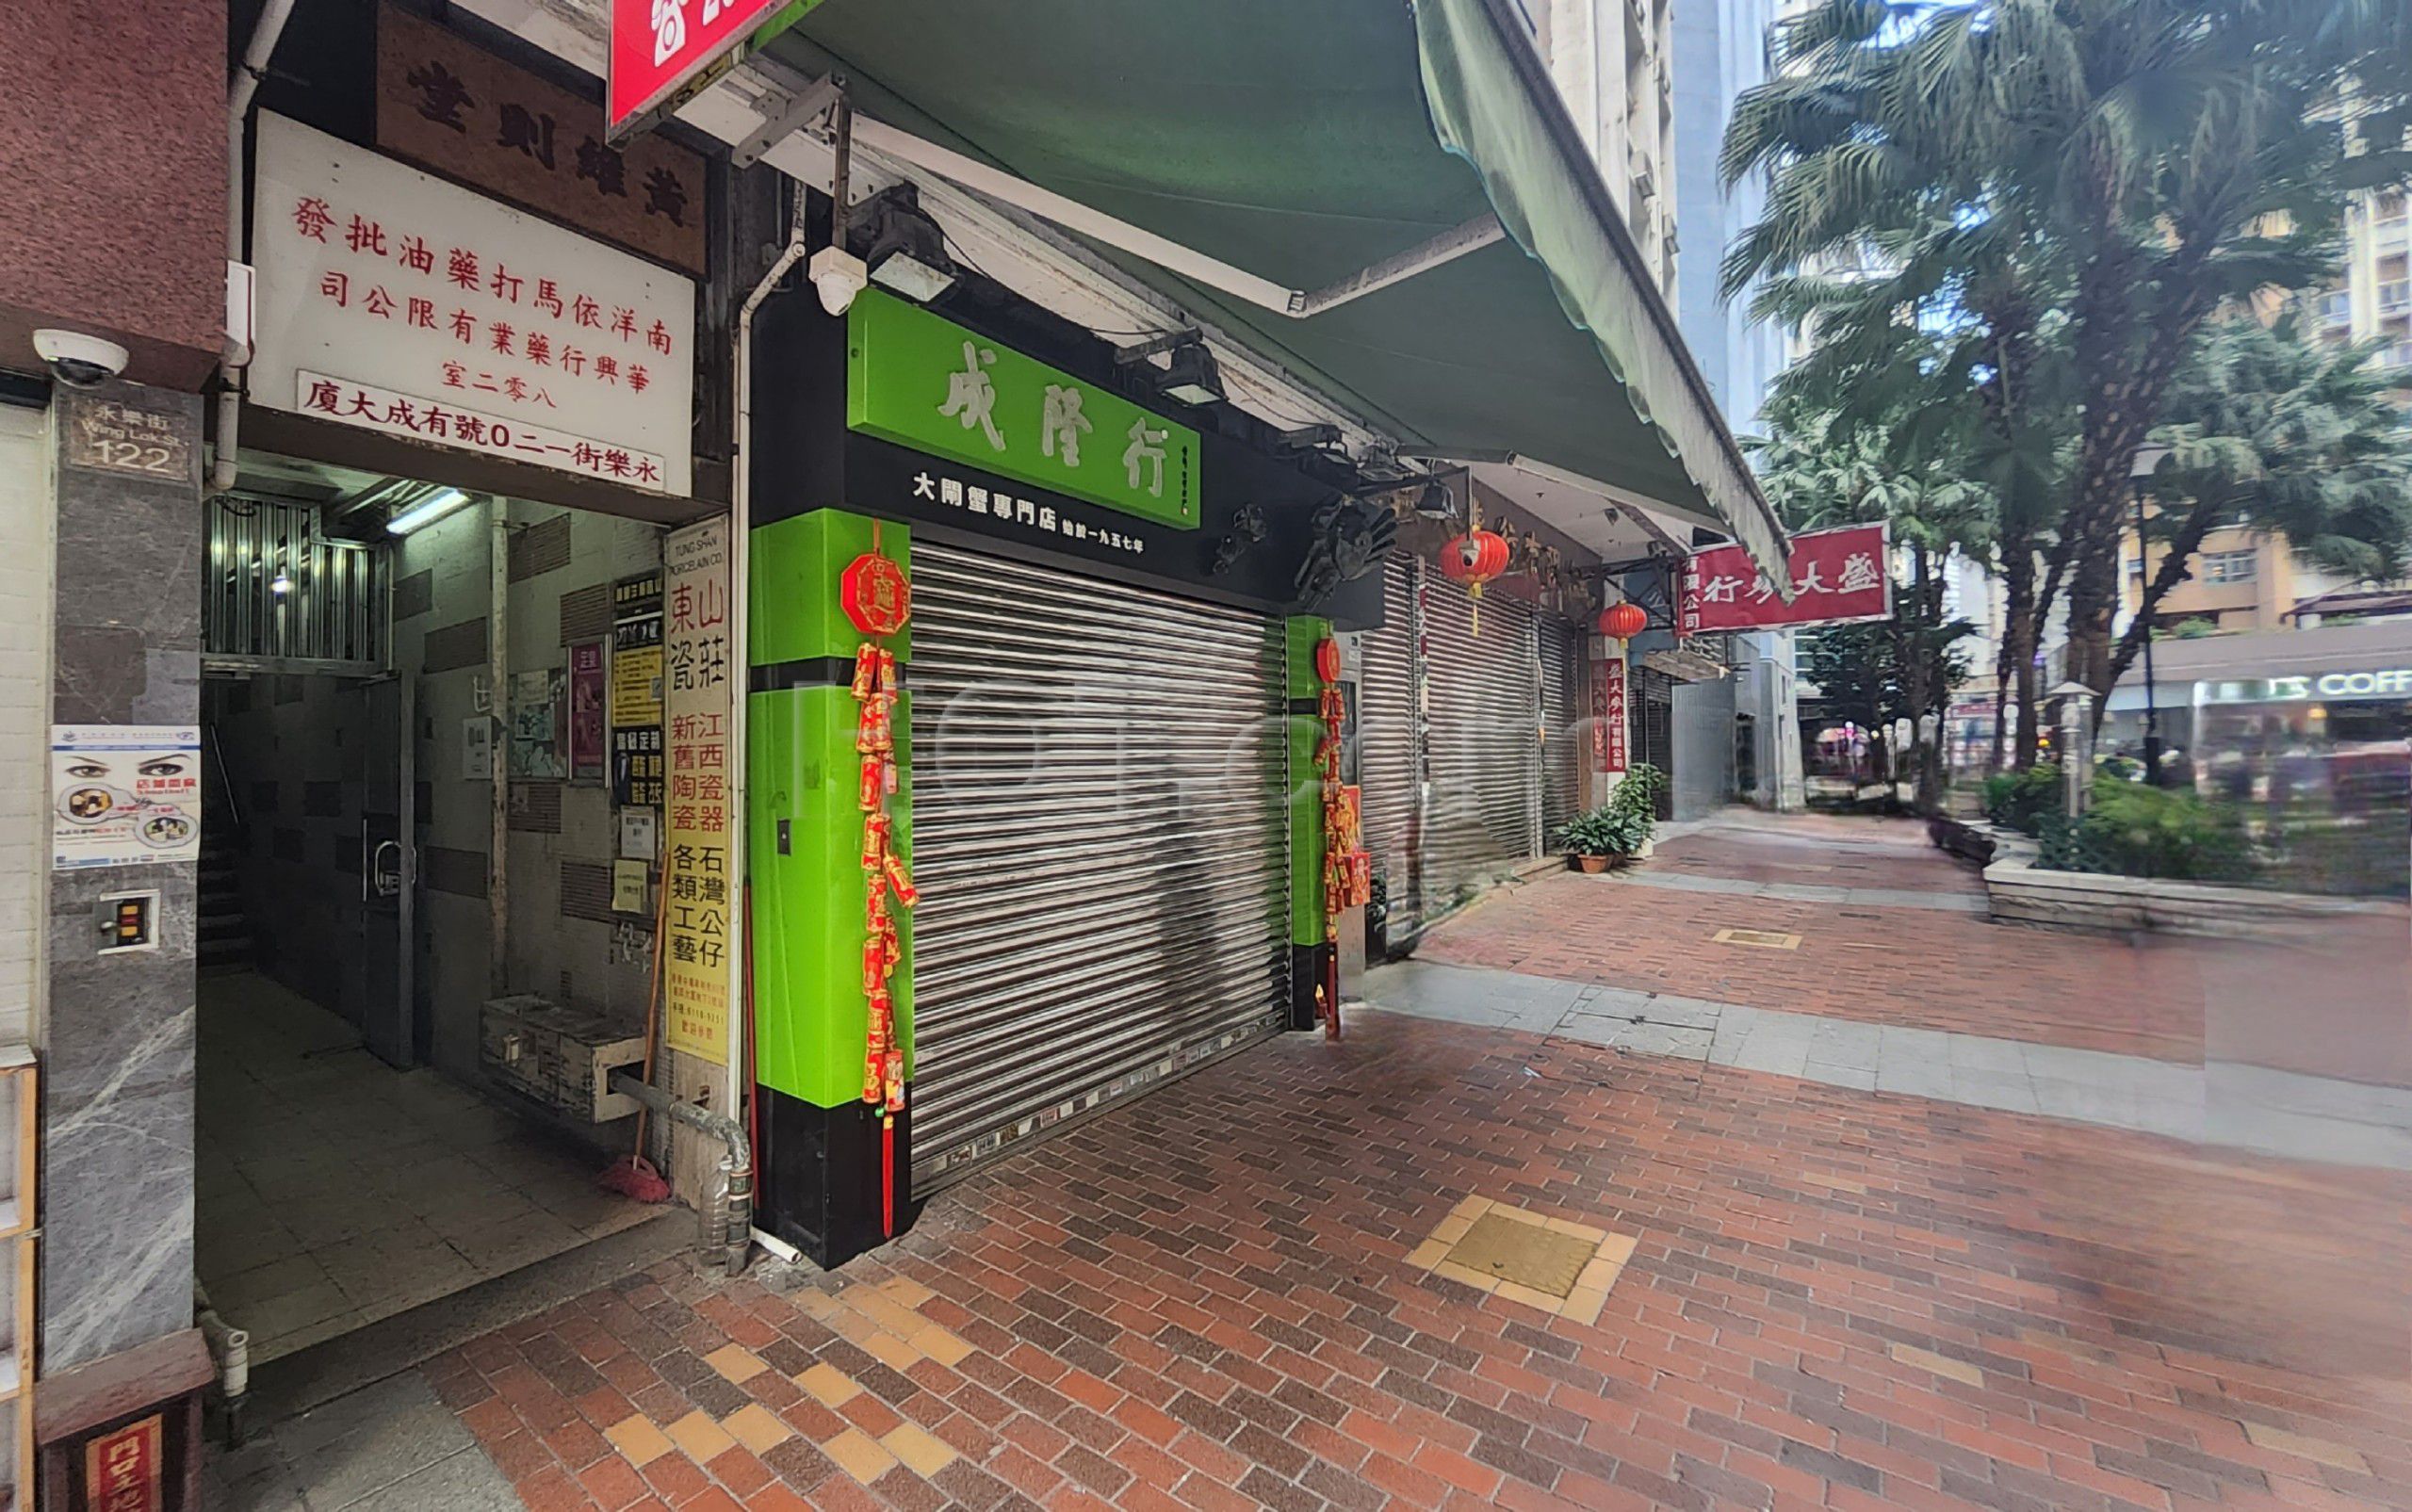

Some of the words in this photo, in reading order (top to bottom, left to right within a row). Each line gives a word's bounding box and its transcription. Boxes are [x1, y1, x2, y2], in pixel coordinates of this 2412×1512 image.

[292, 196, 672, 356] 南洋依馬打藥油批發
[321, 271, 649, 395] 華興行藥業有限公司
[442, 361, 557, 409] 八零二室
[81, 417, 124, 440] Wing
[92, 440, 171, 472] 122
[696, 534, 717, 554] SHAN
[671, 579, 724, 634] 東山
